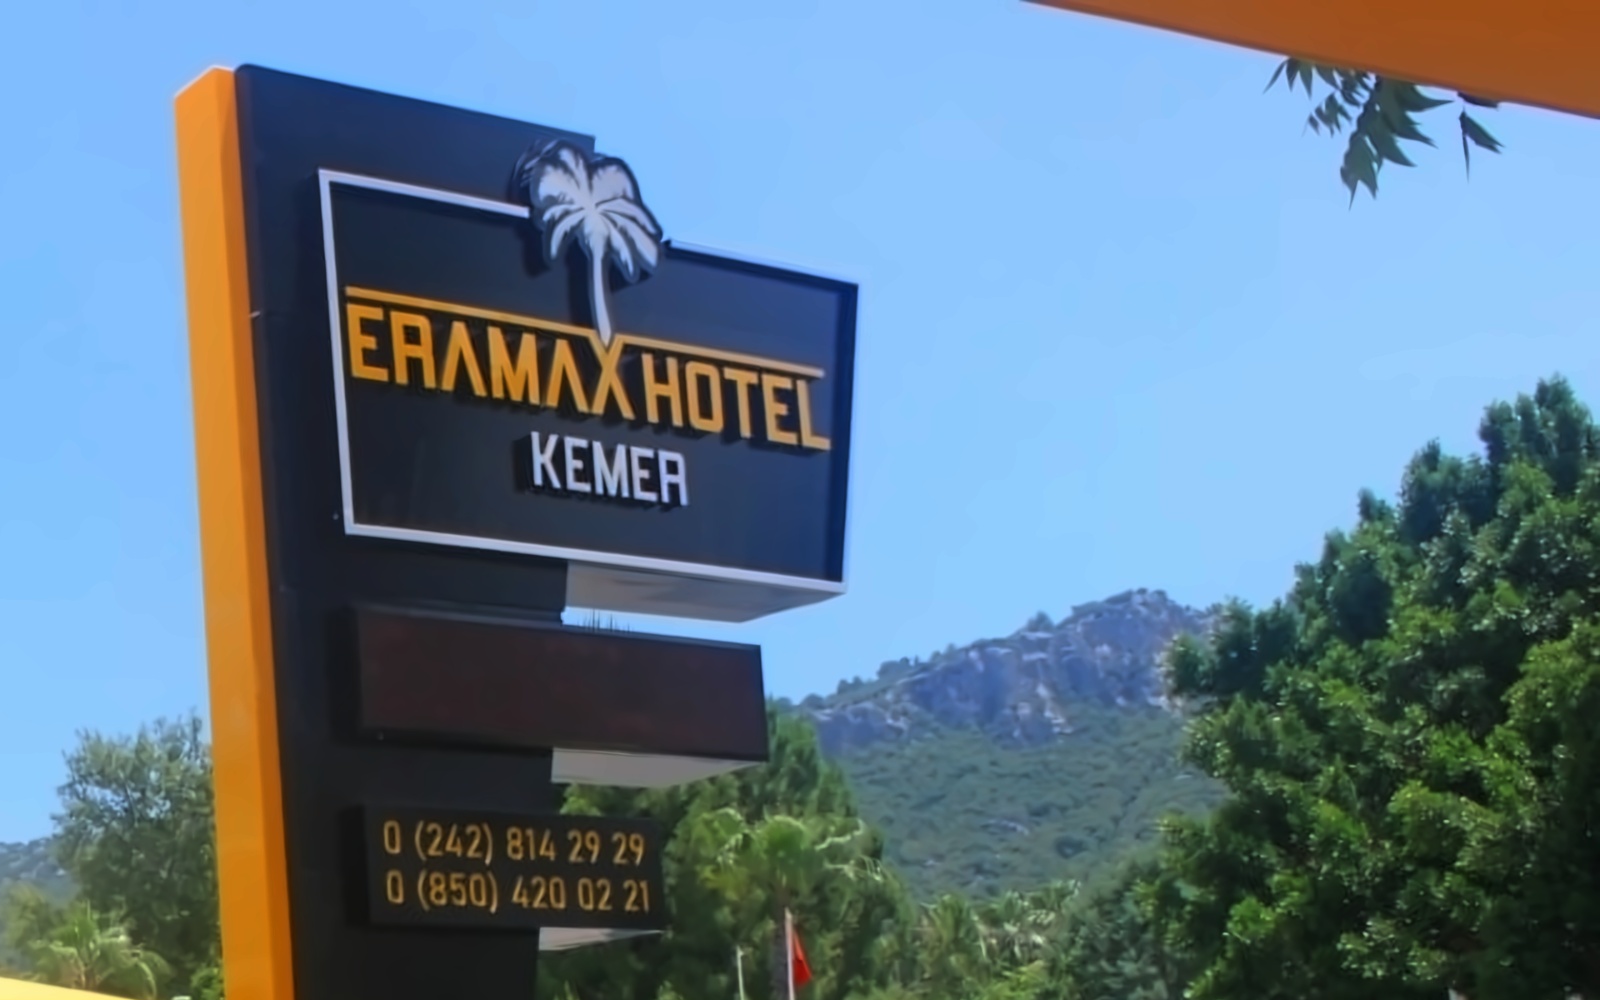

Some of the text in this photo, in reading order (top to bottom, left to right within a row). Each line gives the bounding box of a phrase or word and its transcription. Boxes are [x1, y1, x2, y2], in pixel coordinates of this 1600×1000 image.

[345, 302, 832, 451] ERAMAX HOTEL
[530, 431, 689, 507] KEMER
[383, 820, 645, 866] 0 (242) 814 29 29
[386, 869, 649, 914] 0 (850) 420 02 21
